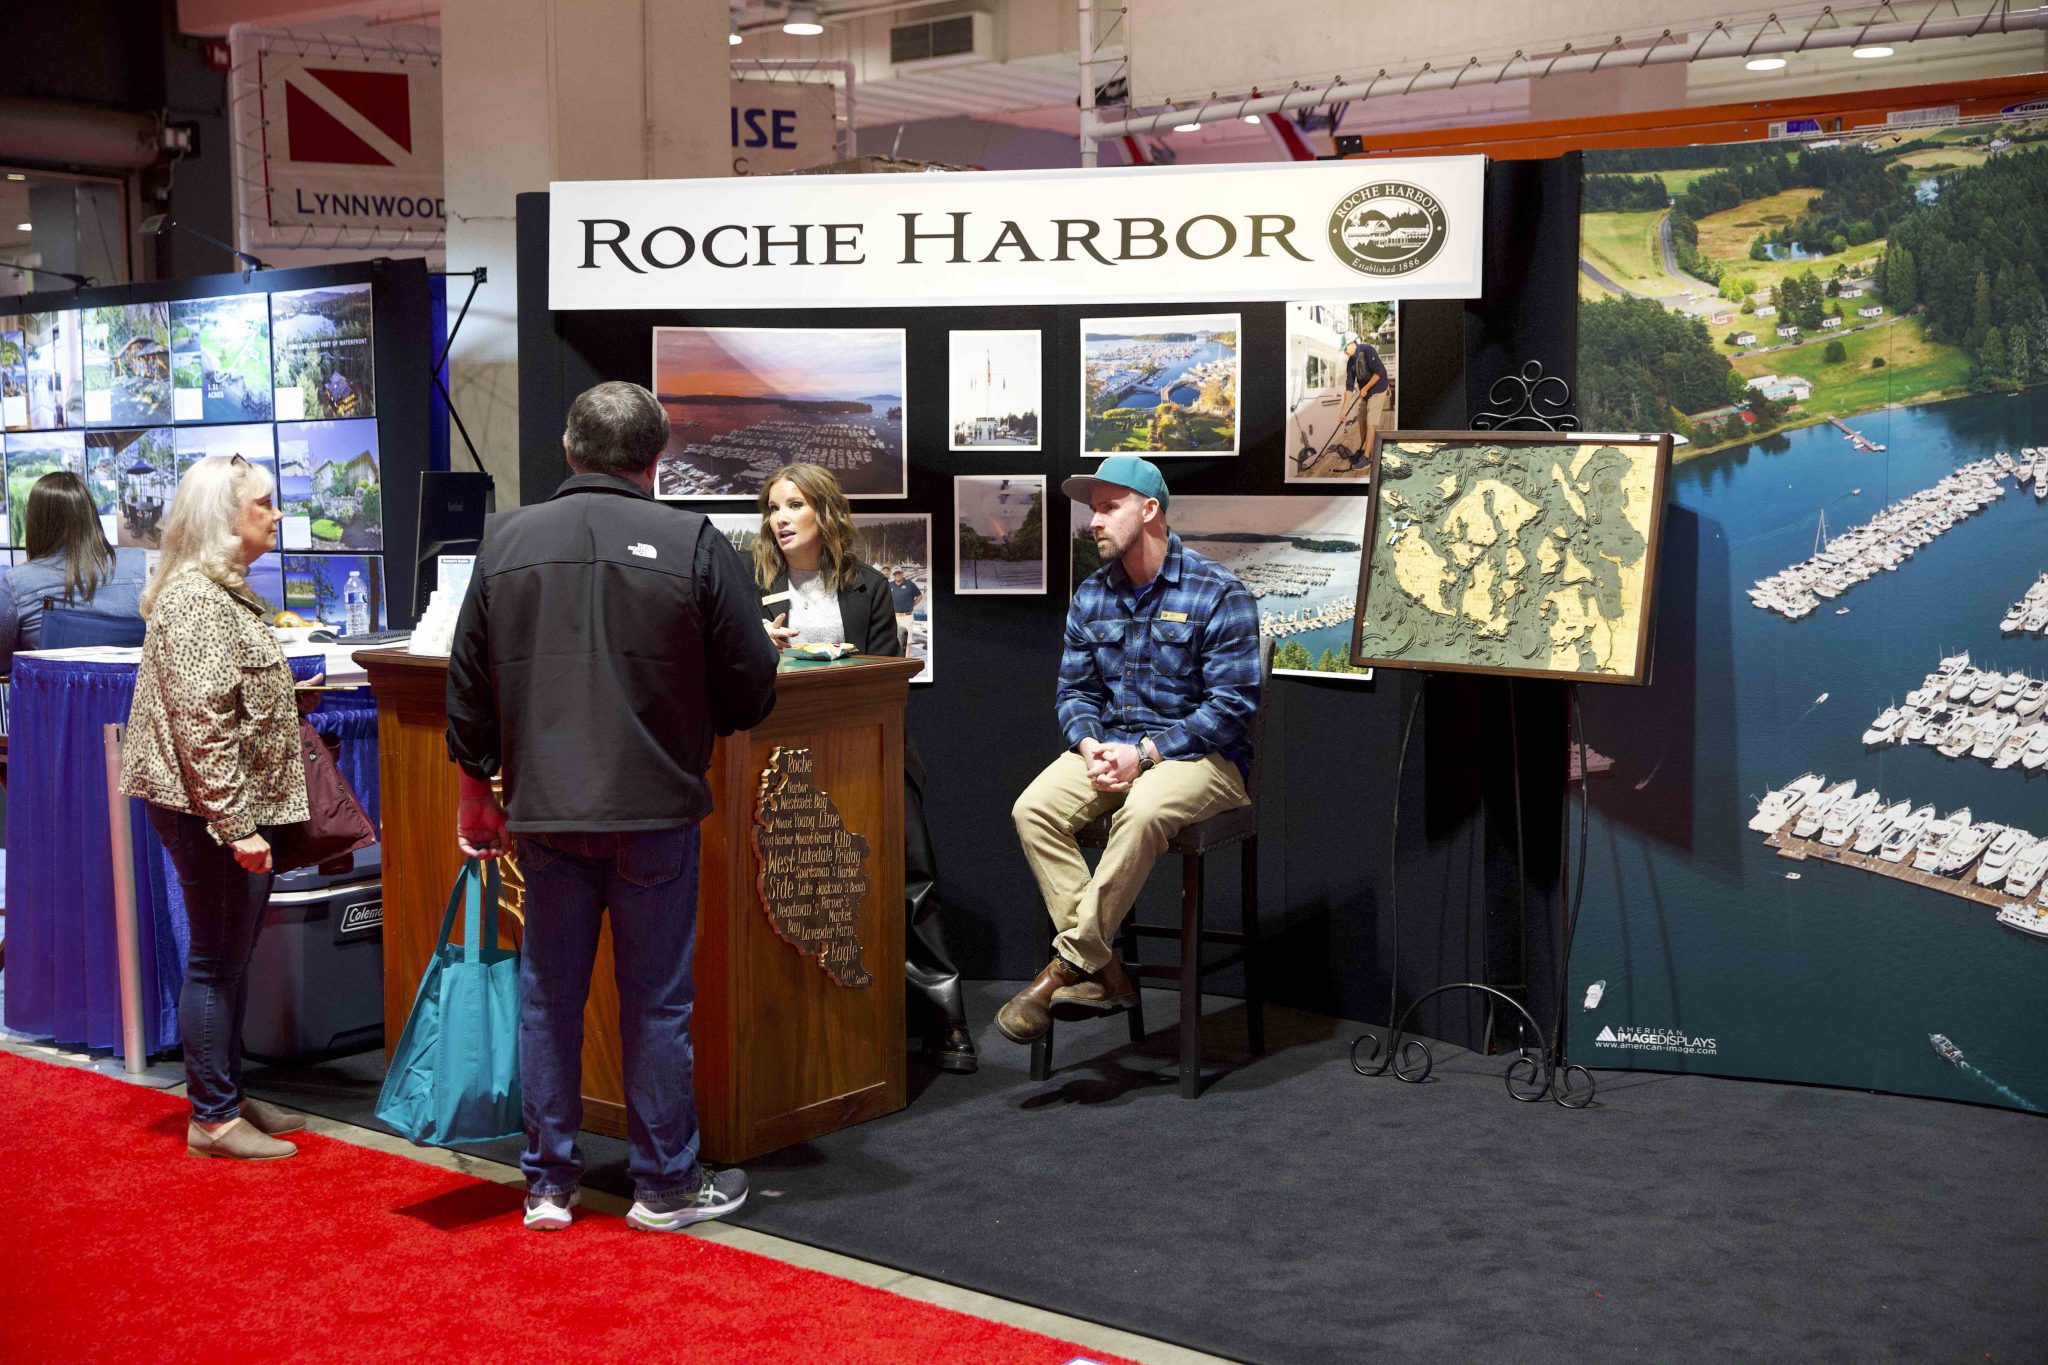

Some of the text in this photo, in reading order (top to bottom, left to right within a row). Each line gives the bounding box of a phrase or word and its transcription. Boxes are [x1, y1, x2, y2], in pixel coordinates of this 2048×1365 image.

[1335, 184, 1439, 219] ROCHE HARBOR
[577, 212, 1315, 274] ROCHE HARBOR
[1352, 257, 1420, 273] Established 1886
[787, 755, 812, 773] Roche
[787, 781, 808, 793] Harbor
[780, 793, 828, 811] Westcott Bay
[775, 813, 815, 830] Mount Young
[818, 811, 840, 828] Lime
[774, 834, 793, 845] Harbor
[794, 831, 832, 845] Mount Grant
[833, 830, 852, 848] Kiln
[767, 849, 795, 874] West
[797, 846, 833, 864] Lakedale
[834, 847, 861, 866] Friday
[837, 865, 858, 878] Harbor
[768, 875, 794, 900] Side
[797, 879, 813, 896] Lake
[849, 881, 866, 893] Beach
[350, 907, 383, 922] Colema
[828, 908, 852, 923] Market
[787, 919, 801, 936] Bay
[801, 923, 854, 940] Lavender Farm
[831, 940, 858, 965] Eagle
[841, 966, 856, 980] Cove
[1617, 1026, 1683, 1036] AMERICAN
[1594, 1041, 1717, 1055] www.american-image.com
[1617, 1032, 1717, 1049] IMAGEDISPLAYS
